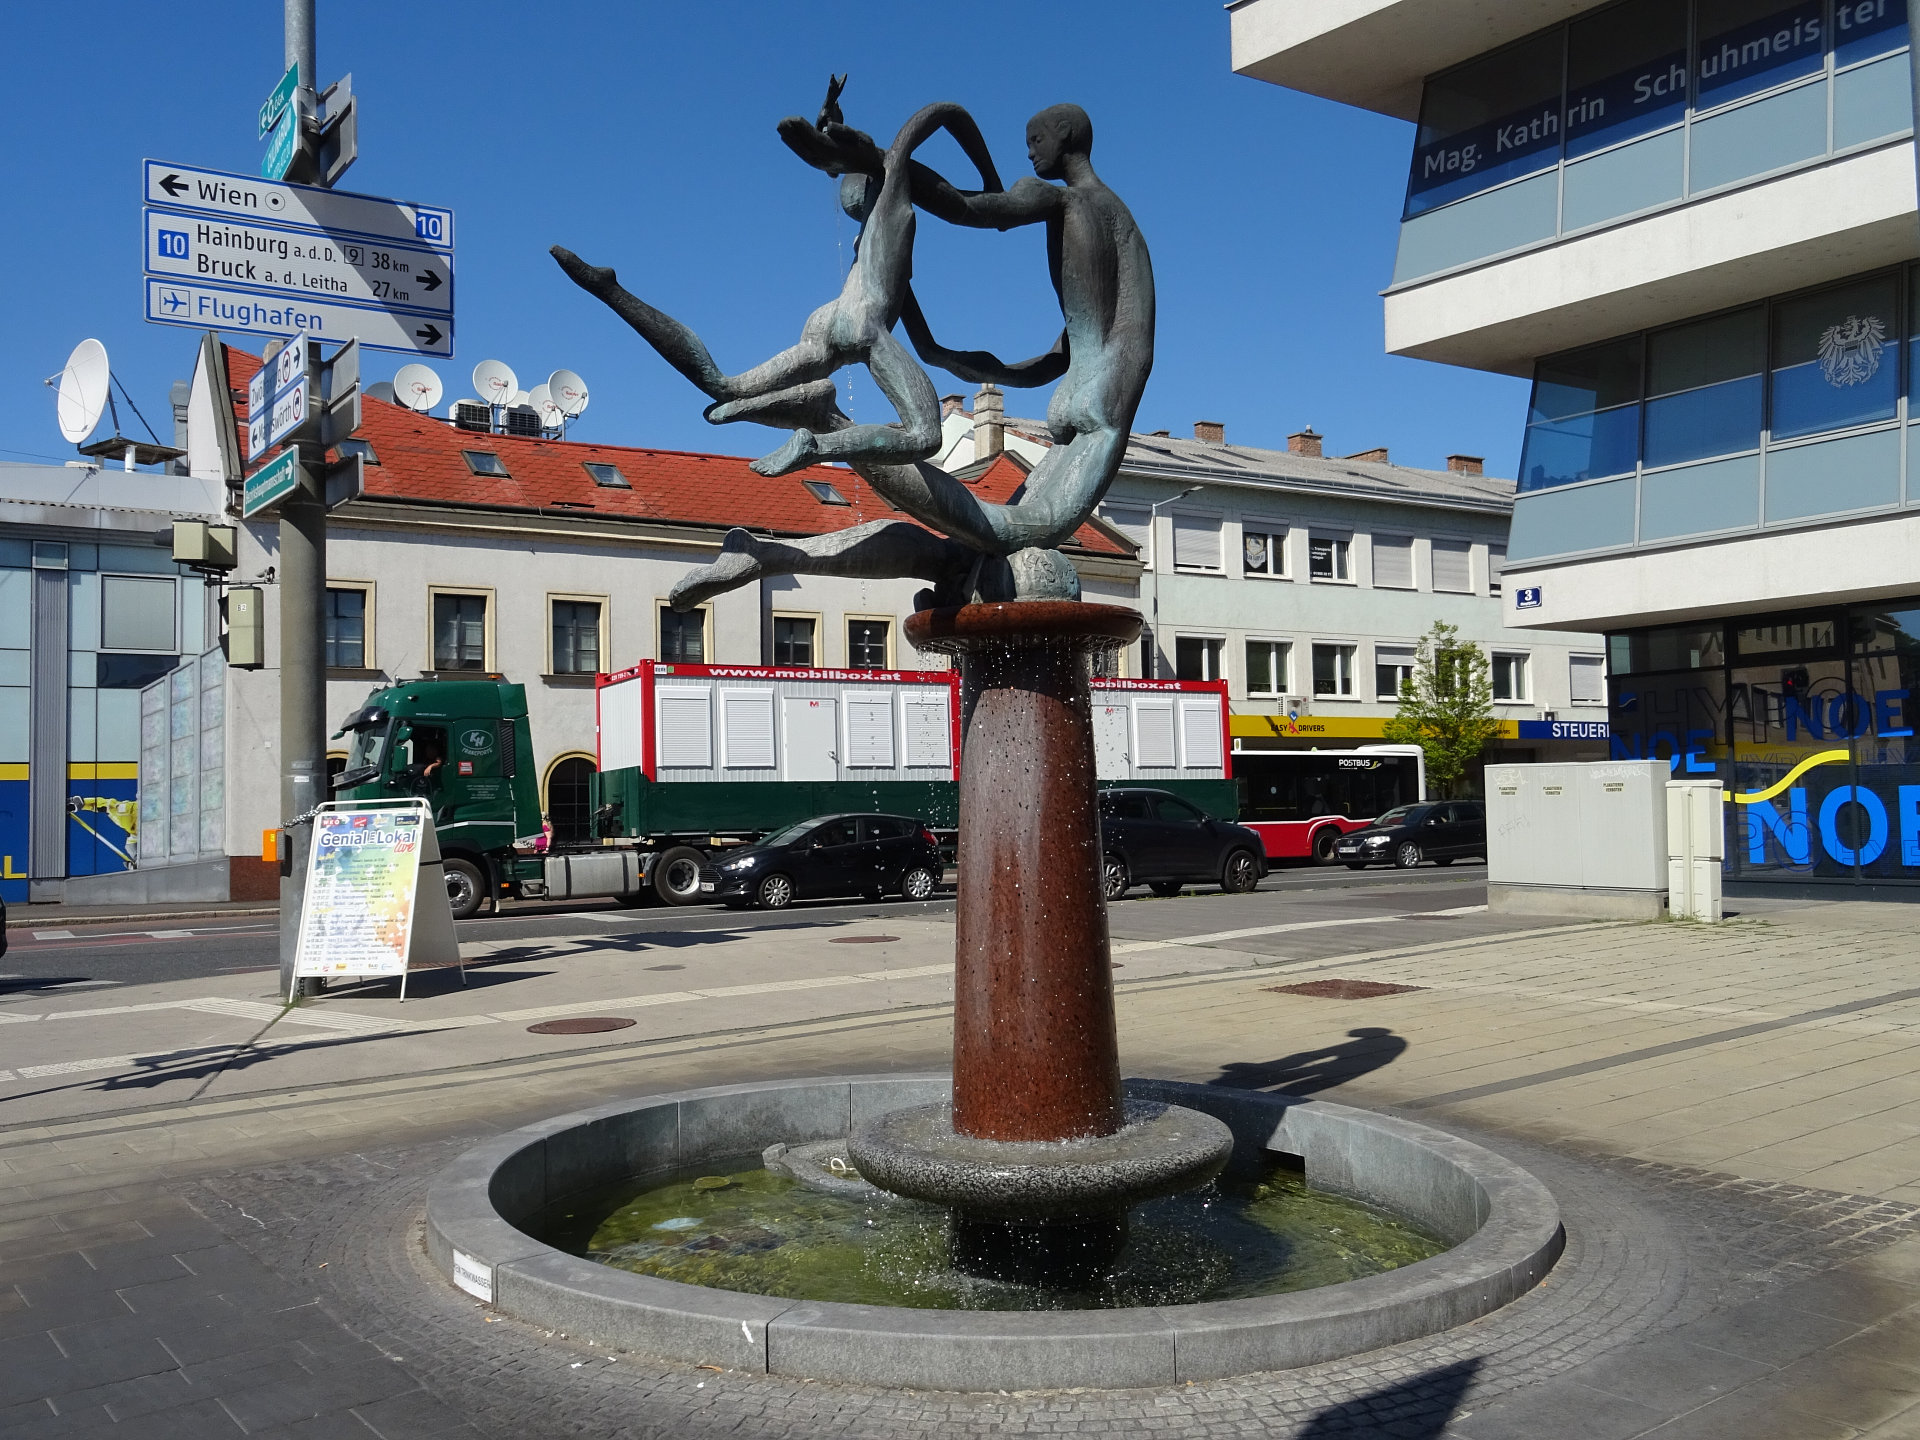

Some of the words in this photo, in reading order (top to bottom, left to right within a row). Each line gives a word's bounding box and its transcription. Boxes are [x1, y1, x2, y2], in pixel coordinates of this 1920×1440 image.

[1424, 143, 1482, 179] Mag.
[1497, 97, 1605, 152] Kathrin
[198, 180, 257, 207] Wien
[417, 216, 442, 237] 10
[162, 233, 186, 256] 10
[198, 224, 288, 259] Hainburg
[348, 250, 359, 262] 9
[371, 252, 390, 270] 38
[393, 260, 409, 273] km
[198, 254, 256, 280] Bruck
[303, 274, 348, 292] Leitha
[373, 281, 390, 298] 27
[393, 289, 409, 301] km
[198, 296, 322, 330] Flughafen
[1524, 590, 1533, 601] 3
[709, 668, 901, 681] www.mobilbox.at
[1298, 724, 1325, 732] DRIVERS
[1552, 722, 1610, 738] STEUER
[1785, 689, 1914, 742] NOE
[1338, 759, 1371, 767] POSTBUS
[1610, 729, 1716, 773] NOE
[321, 830, 366, 846] Genial
[377, 829, 417, 844] Lokal
[0, 855, 27, 879] L
